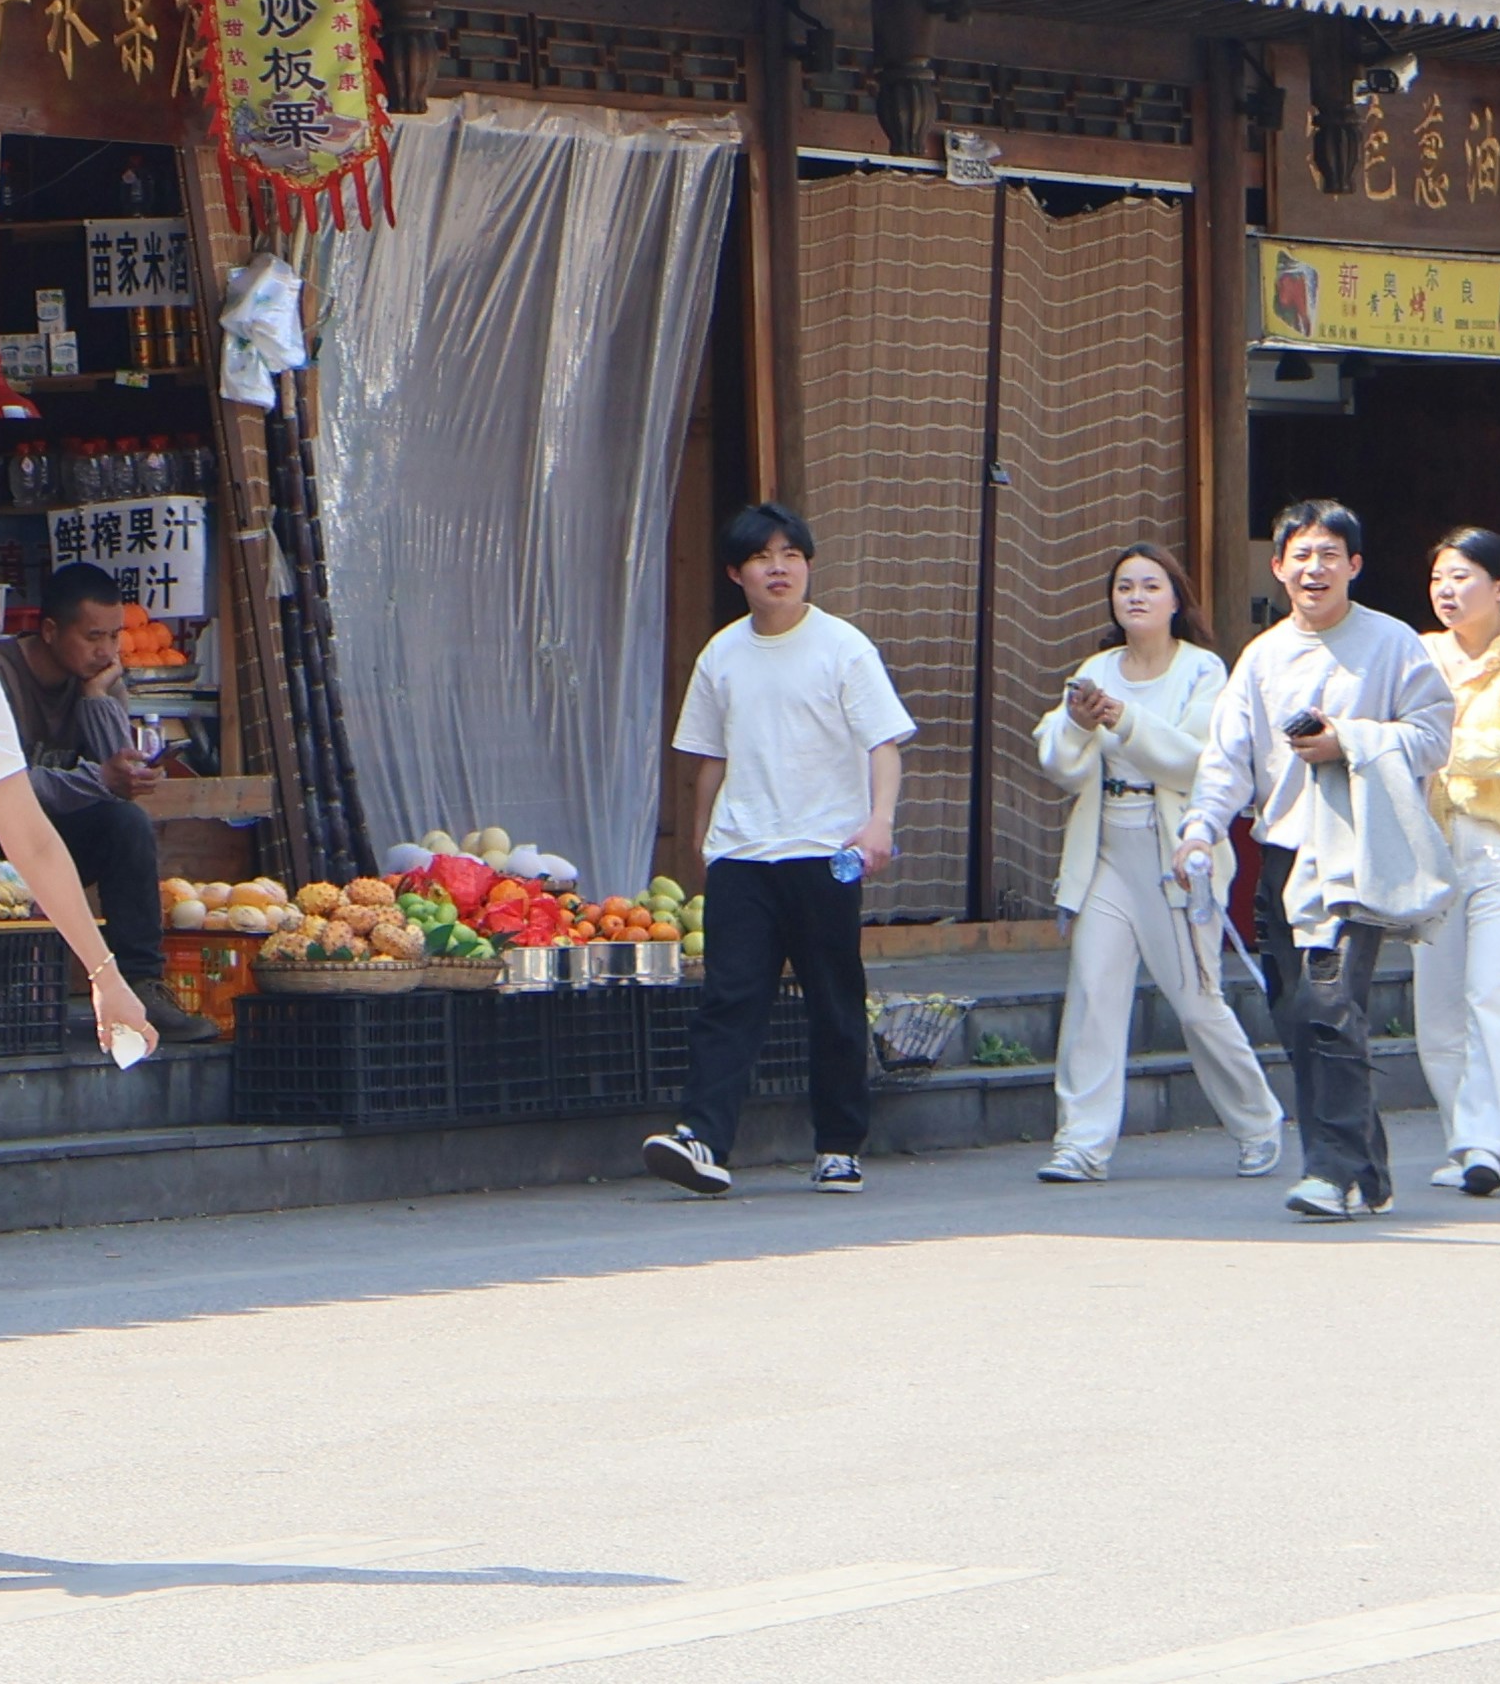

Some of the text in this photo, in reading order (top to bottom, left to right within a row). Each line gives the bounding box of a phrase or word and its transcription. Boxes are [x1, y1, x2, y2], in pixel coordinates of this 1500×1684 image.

[90, 230, 189, 296] 苗家米酒
[53, 505, 199, 562] 鲜榨果汁
